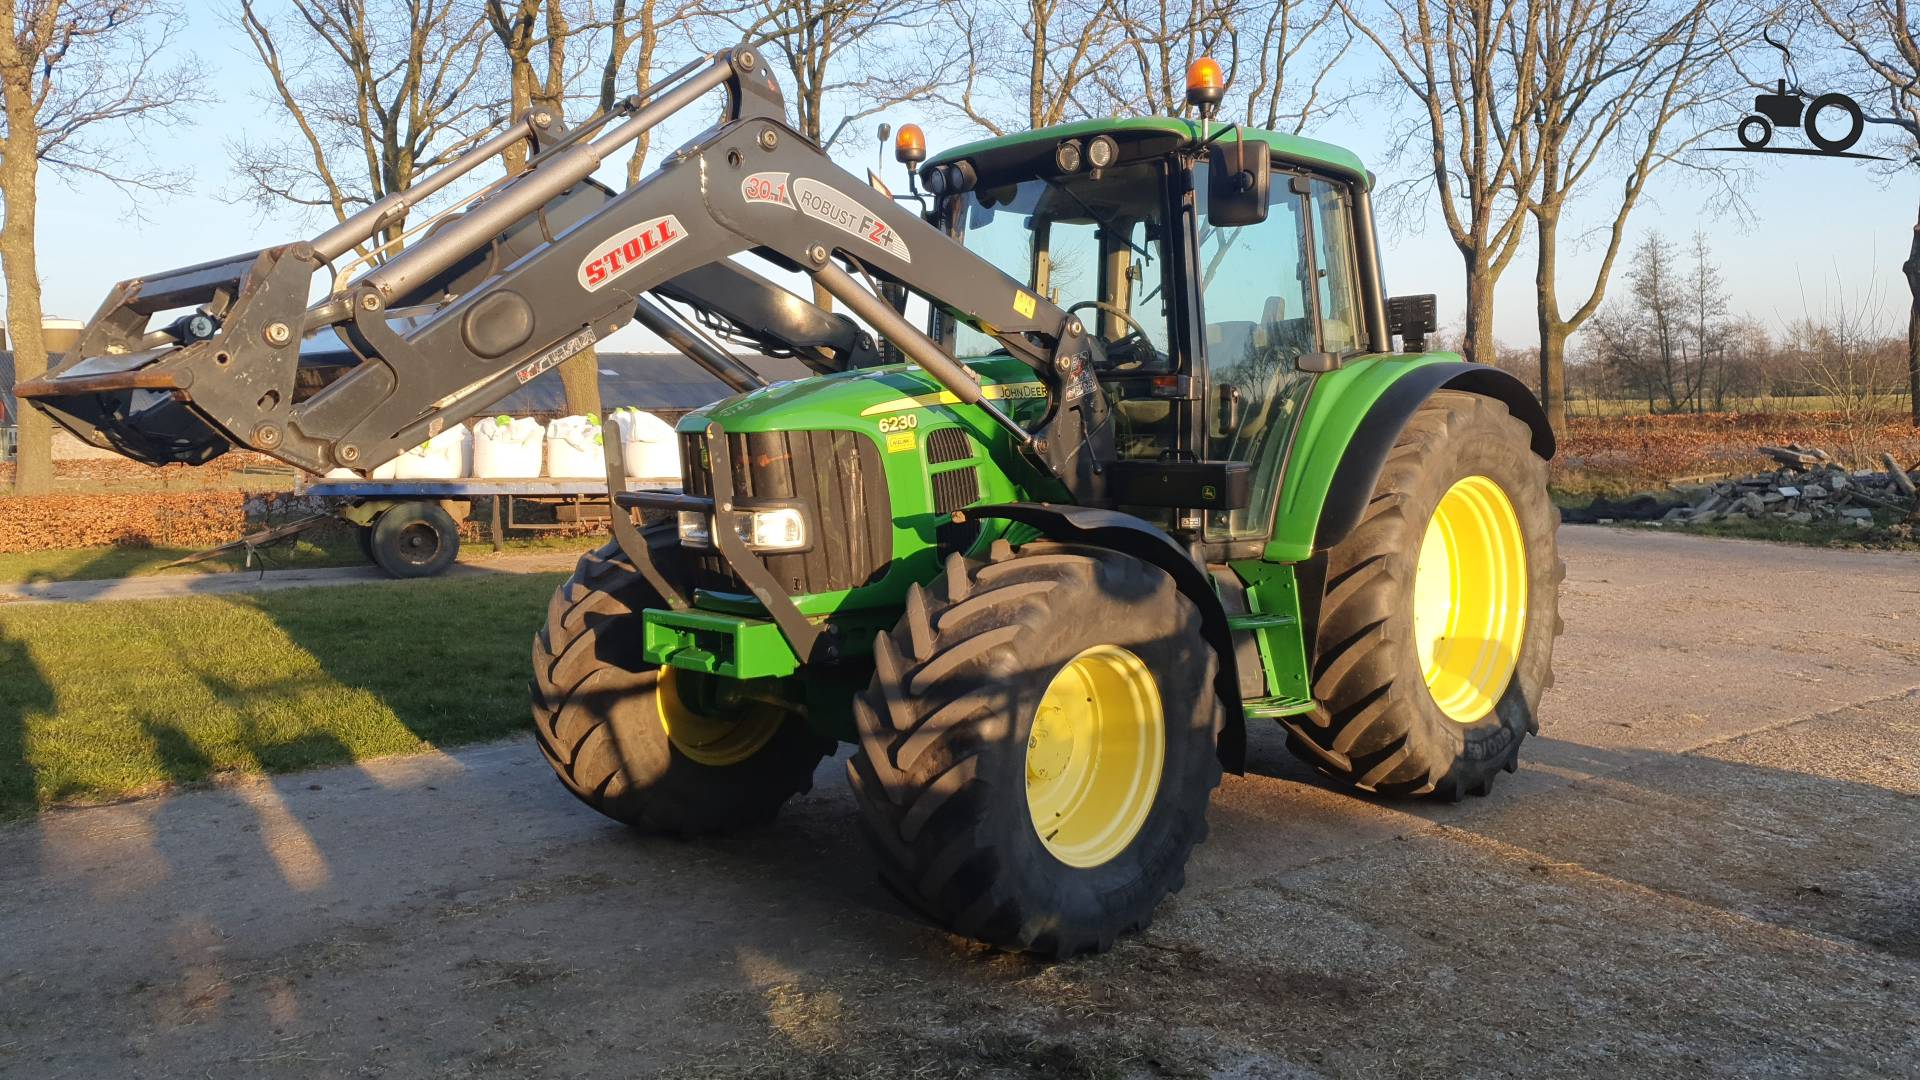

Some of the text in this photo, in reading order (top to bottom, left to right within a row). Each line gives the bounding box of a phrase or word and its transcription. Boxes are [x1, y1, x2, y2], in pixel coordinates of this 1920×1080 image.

[745, 177, 786, 203] 30.1
[801, 190, 894, 246] ROBUST FZ+
[585, 220, 678, 287] STOLL
[1001, 385, 1047, 398] JOHN DEER
[879, 414, 917, 433] 6230
